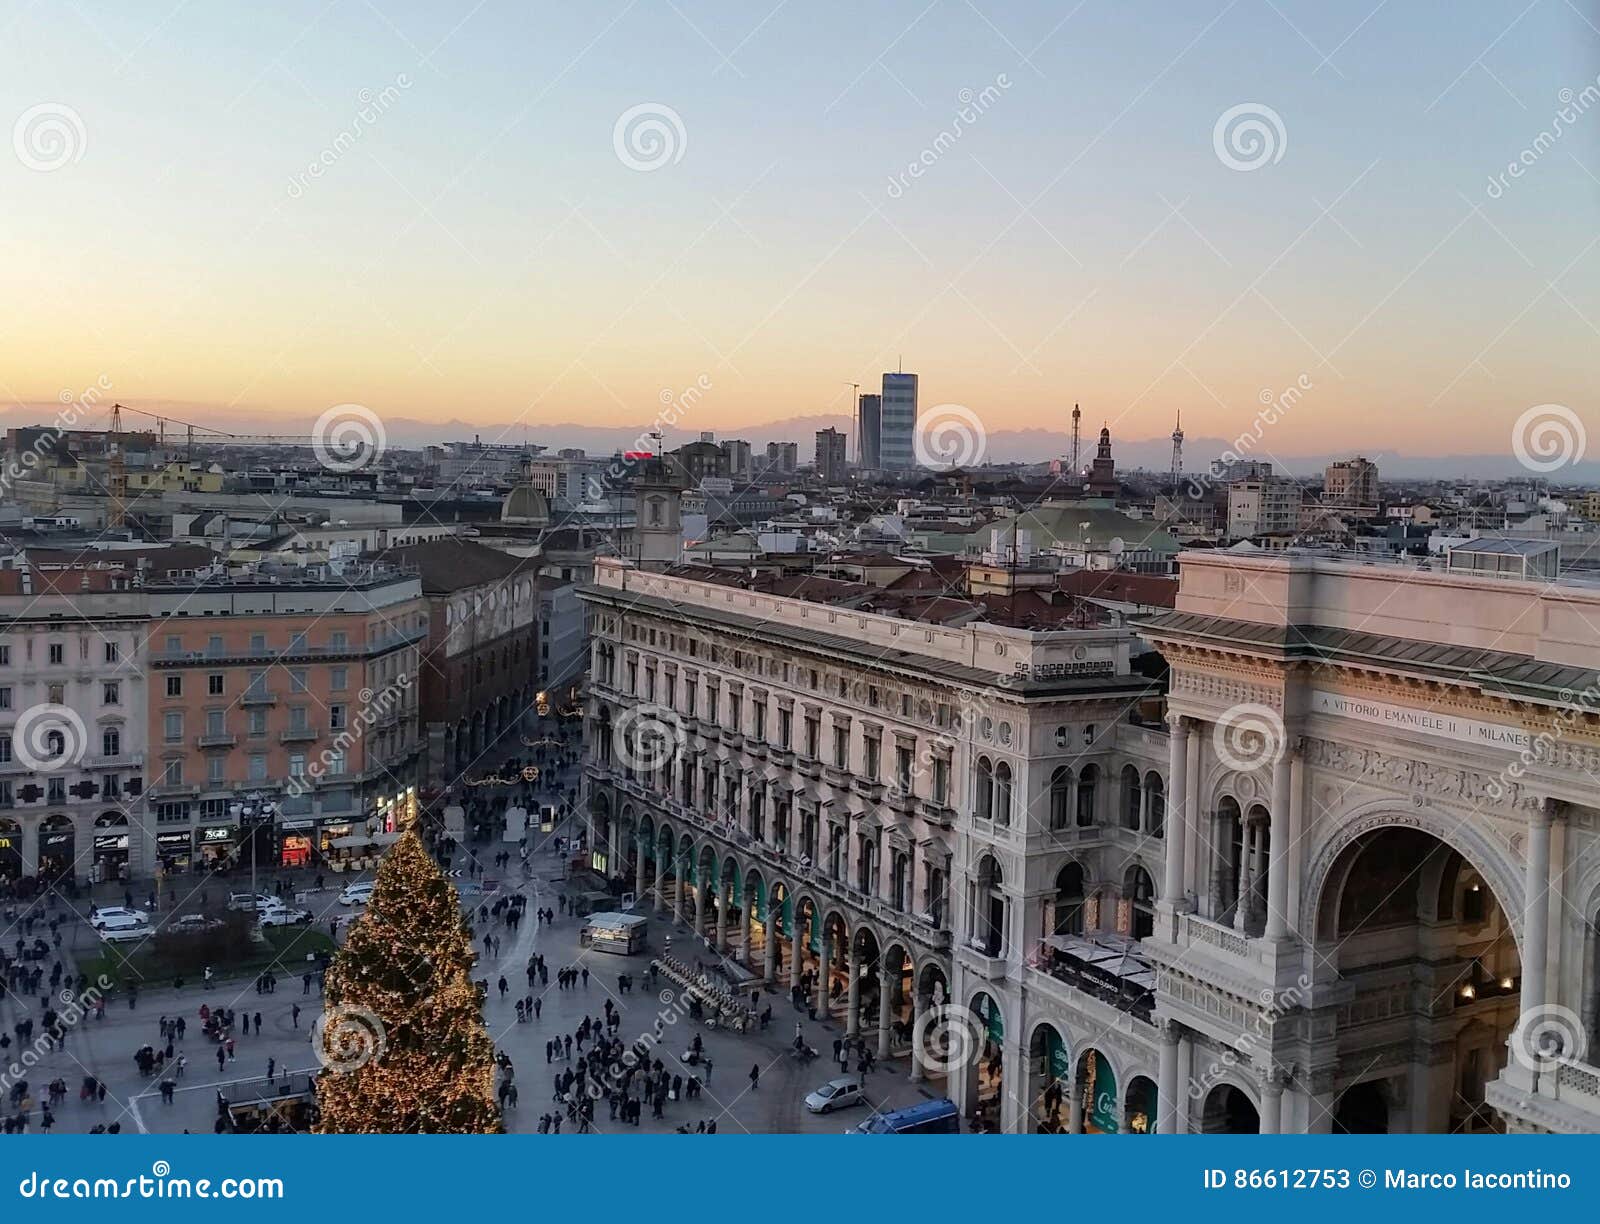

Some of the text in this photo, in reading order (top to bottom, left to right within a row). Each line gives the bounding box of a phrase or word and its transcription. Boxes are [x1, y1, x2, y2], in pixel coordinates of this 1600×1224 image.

[1322, 699, 1329, 708] A
[1334, 700, 1380, 717] VITTORIO
[1384, 709, 1443, 730] EMANUELE
[1448, 721, 1456, 732] II
